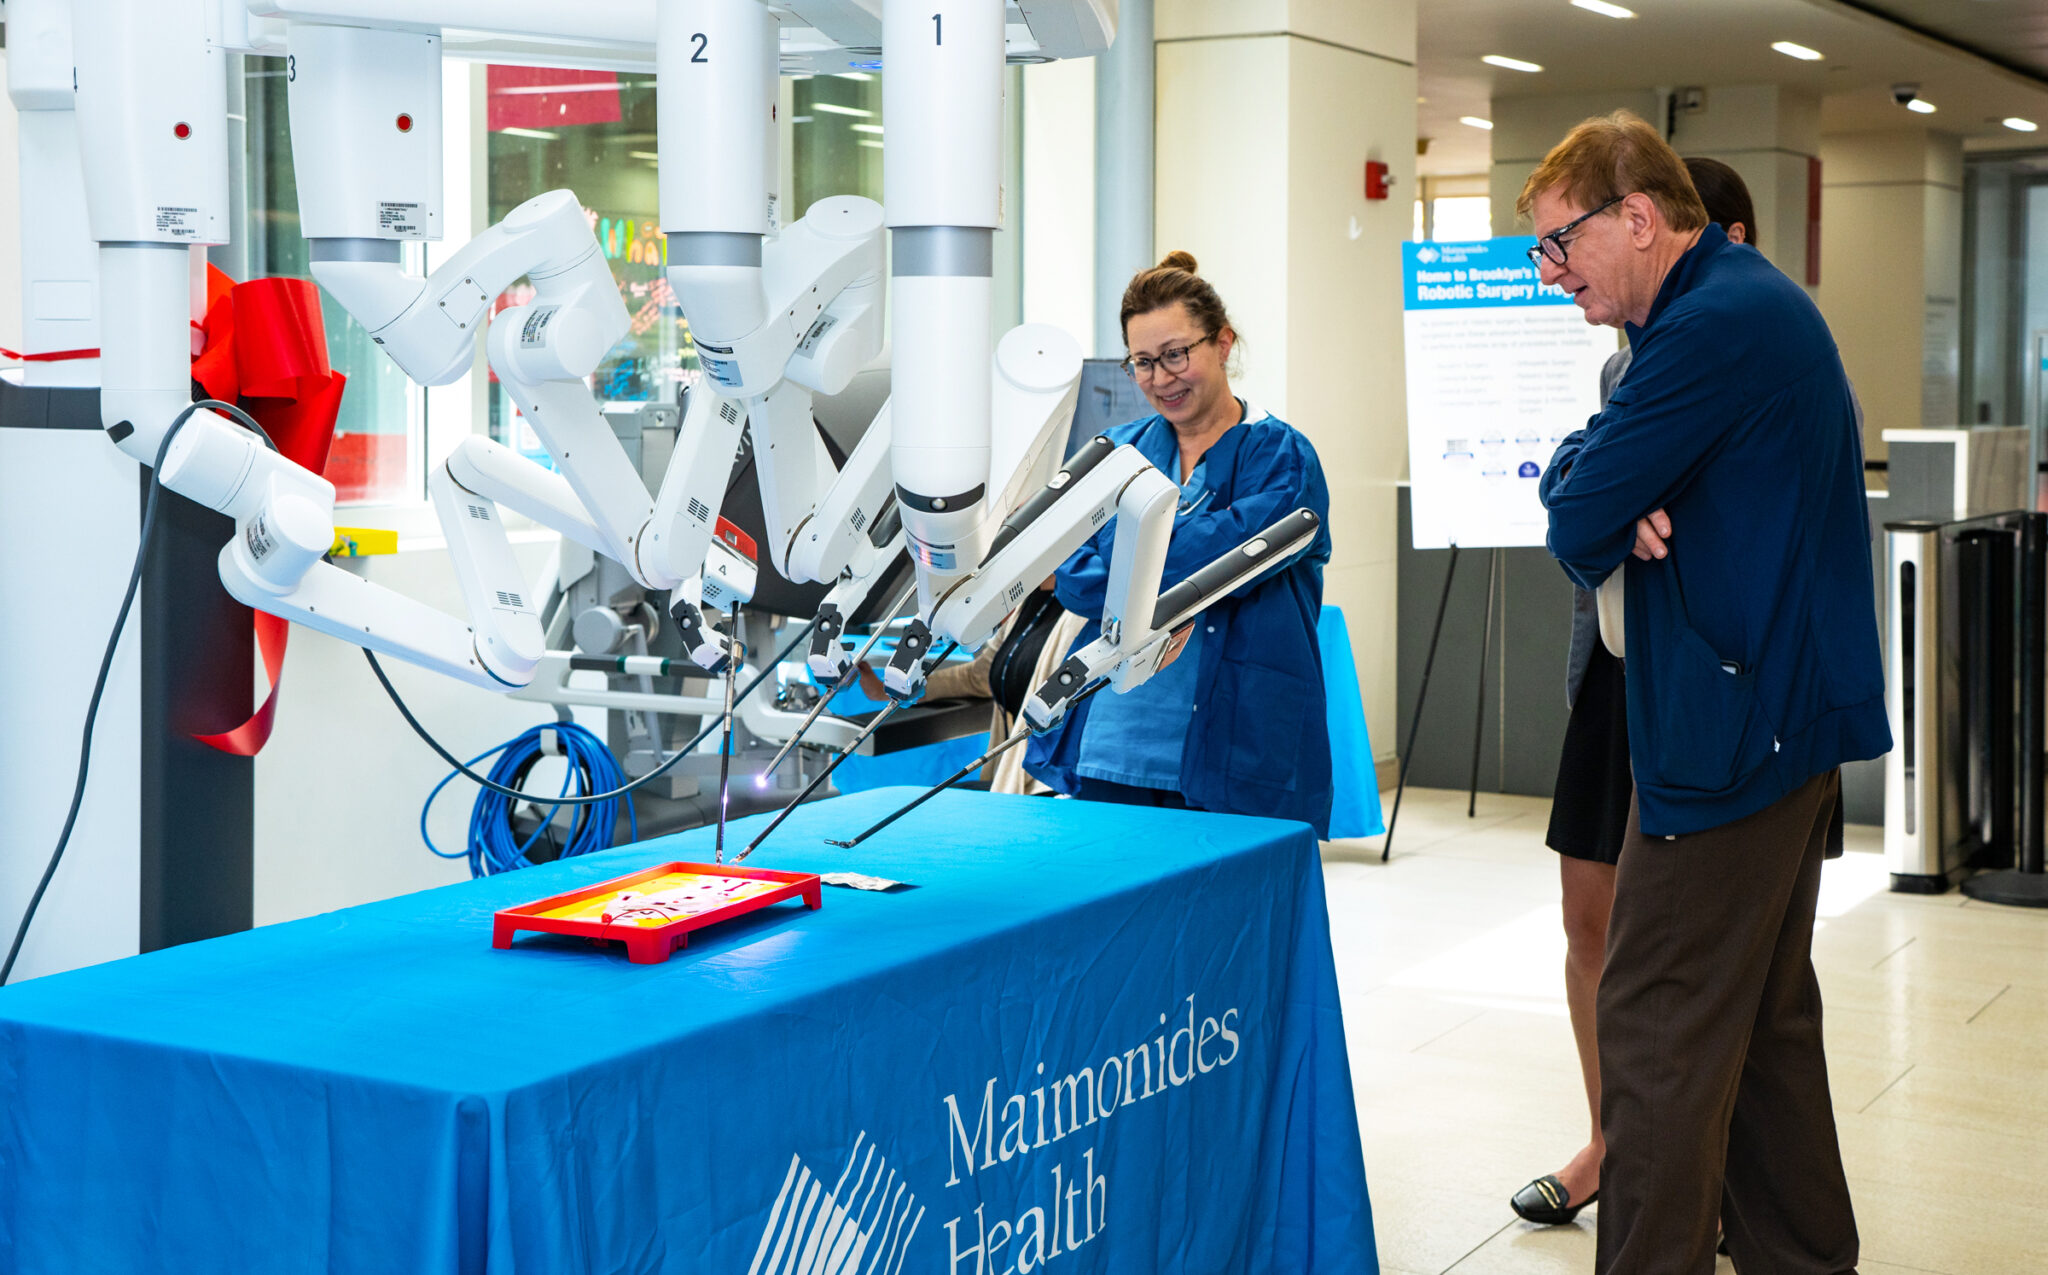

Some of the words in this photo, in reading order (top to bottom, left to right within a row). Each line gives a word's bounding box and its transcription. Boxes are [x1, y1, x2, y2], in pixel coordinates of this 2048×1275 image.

[932, 13, 942, 46] 1
[690, 32, 709, 63] 2
[288, 54, 296, 82] 3
[1416, 270, 1452, 283] Home
[1453, 269, 1468, 282] to
[1469, 266, 1533, 282] Brooklyn's
[1417, 284, 1474, 301] Robotic
[1476, 282, 1535, 300] Surgery
[718, 564, 727, 576] 4
[943, 992, 1240, 1189] Maimonides
[943, 1146, 1106, 1275] Health
